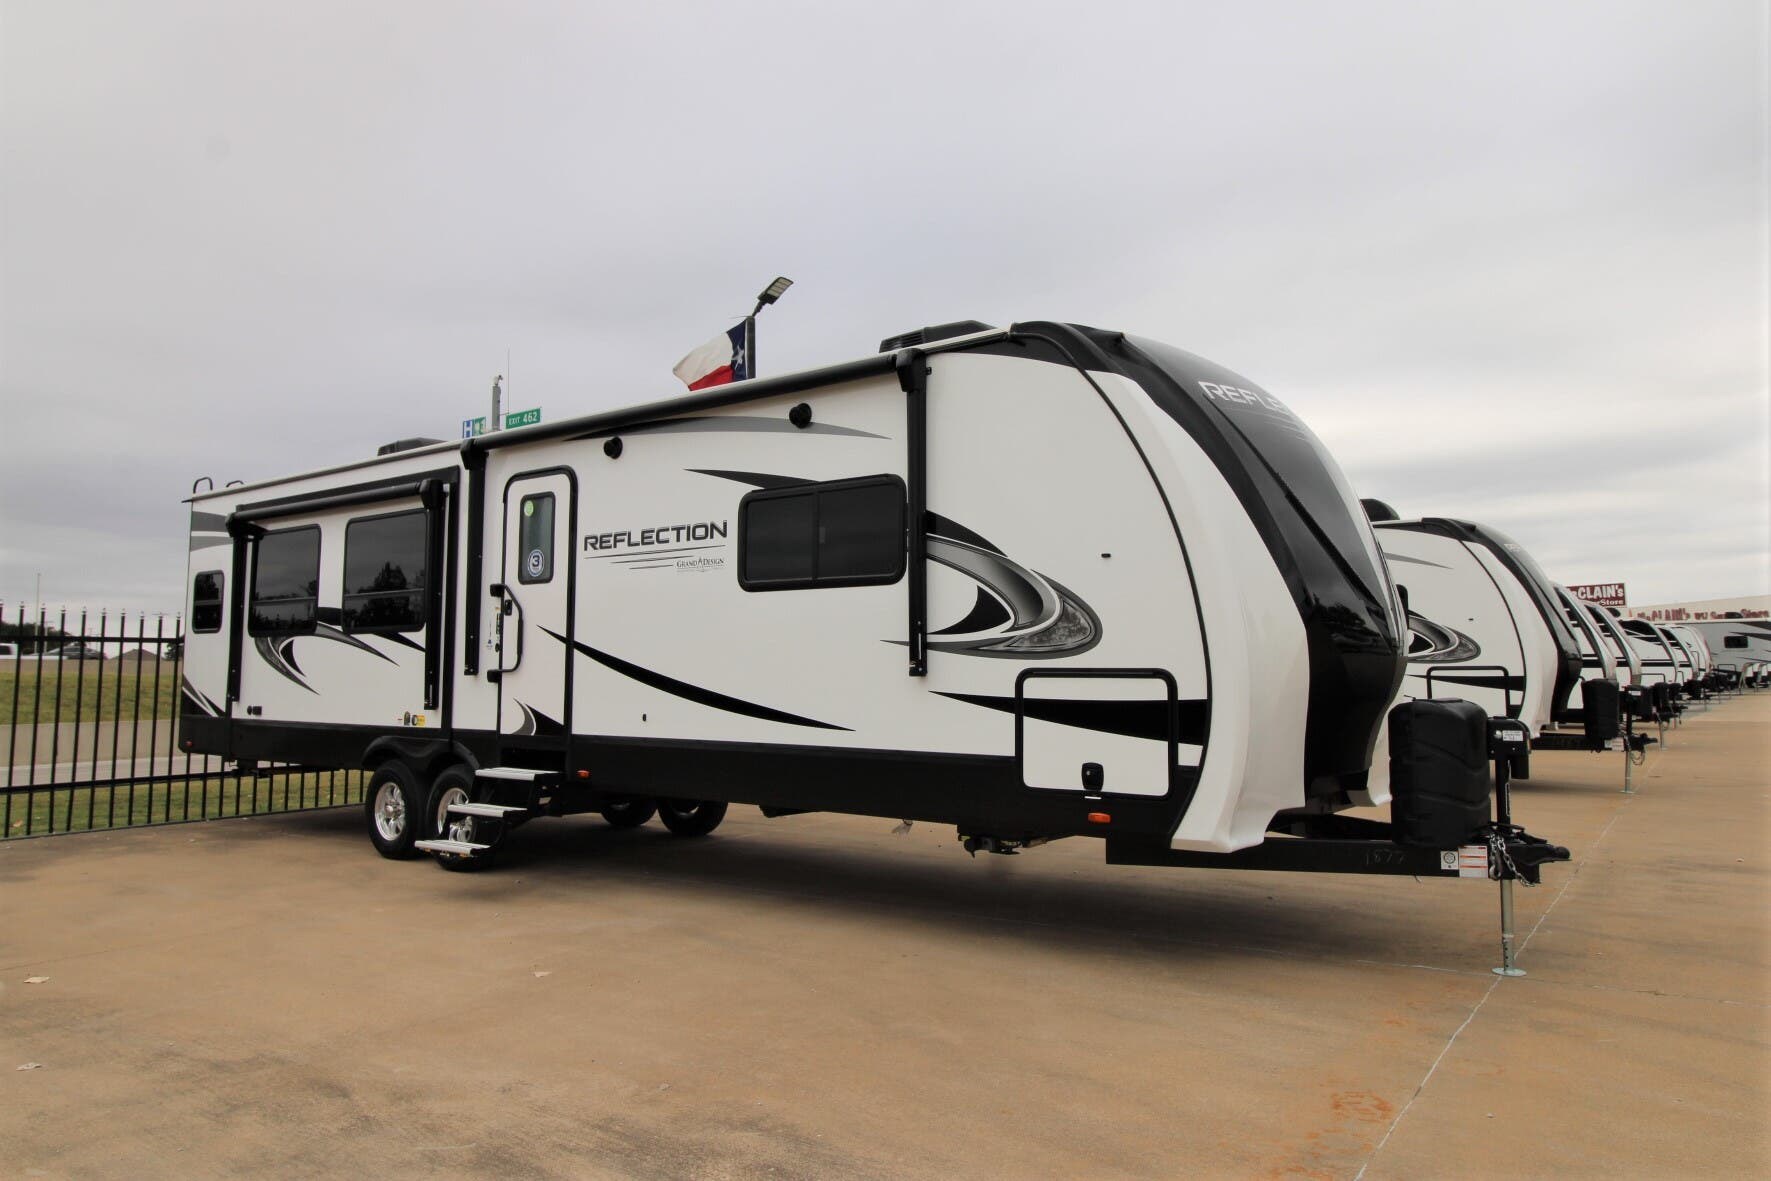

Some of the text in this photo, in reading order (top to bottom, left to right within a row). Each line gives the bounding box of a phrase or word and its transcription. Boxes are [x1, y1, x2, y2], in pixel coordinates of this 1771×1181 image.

[508, 411, 538, 426] EXIT 462
[583, 519, 728, 552] REFLECTION
[532, 555, 541, 567] 3
